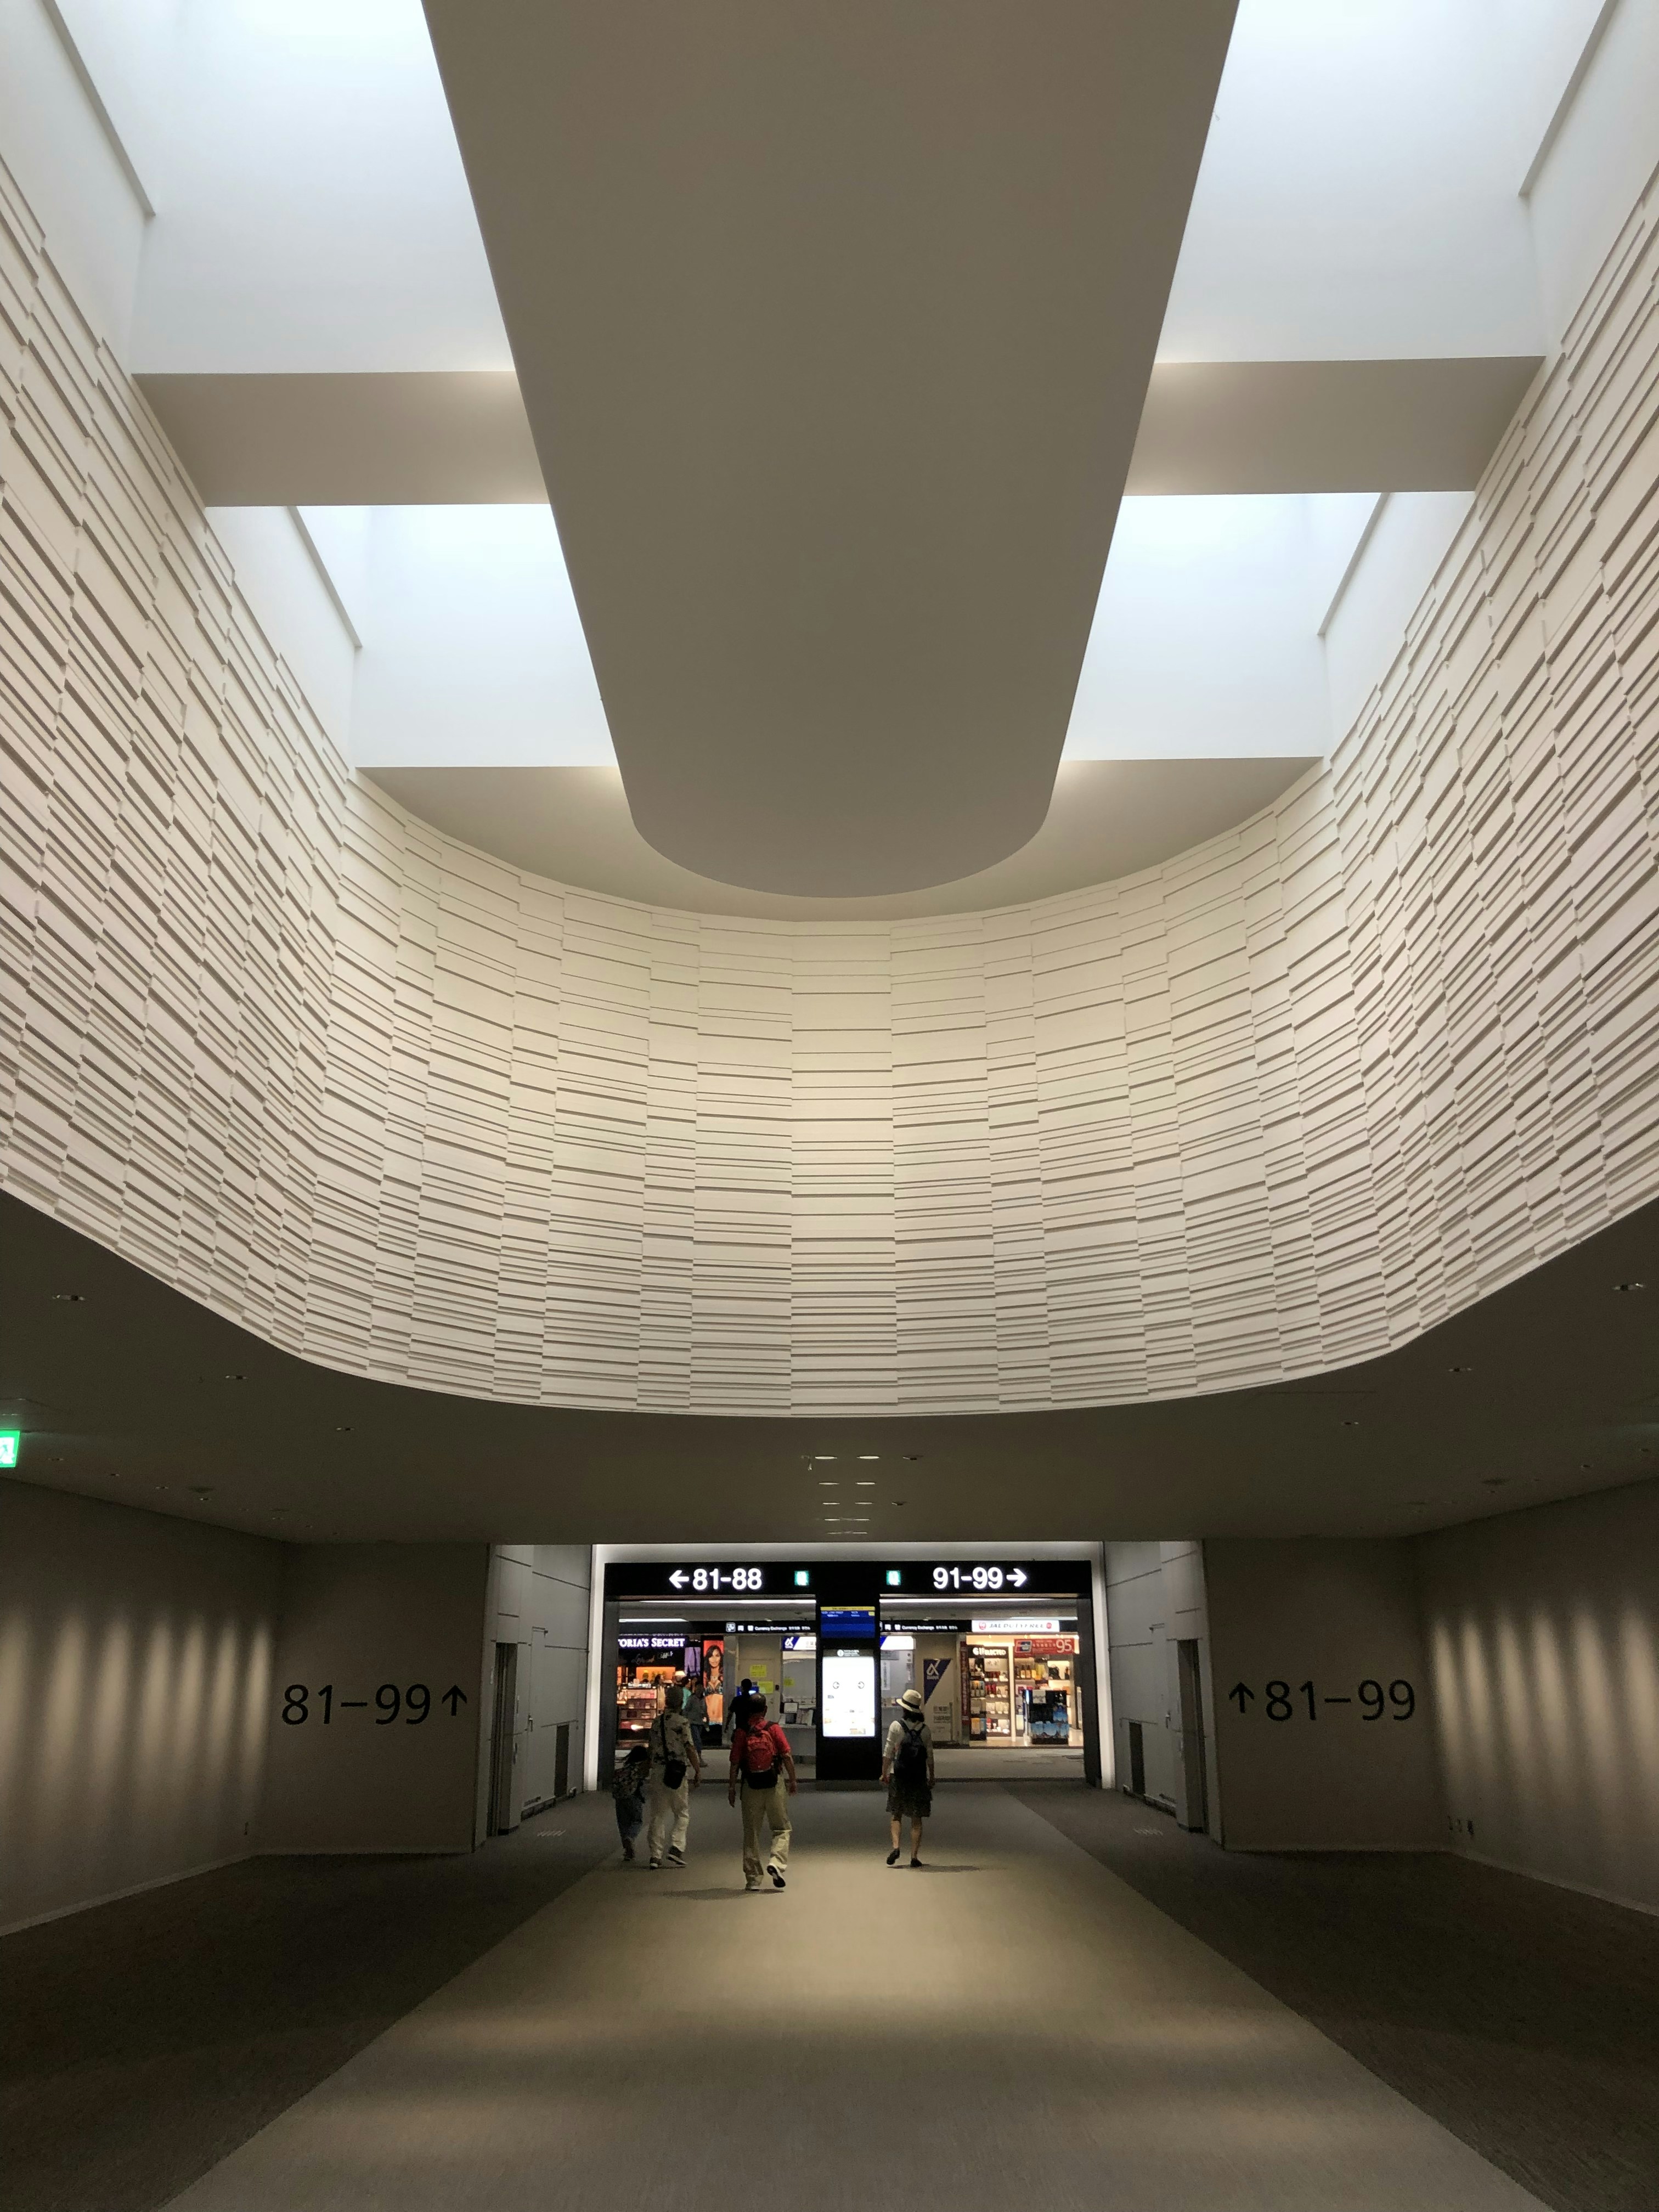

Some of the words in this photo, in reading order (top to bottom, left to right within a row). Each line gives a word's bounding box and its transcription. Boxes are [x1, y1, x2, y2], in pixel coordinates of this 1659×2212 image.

[692, 1568, 762, 1590] 81-88
[933, 1567, 1003, 1589] 91-99
[618, 1638, 649, 1647] ORIA'S
[651, 1638, 685, 1647] SECRET
[1056, 1639, 1072, 1653] 95
[282, 1684, 431, 1725] 81-99
[1265, 1679, 1415, 1722] 81-99
